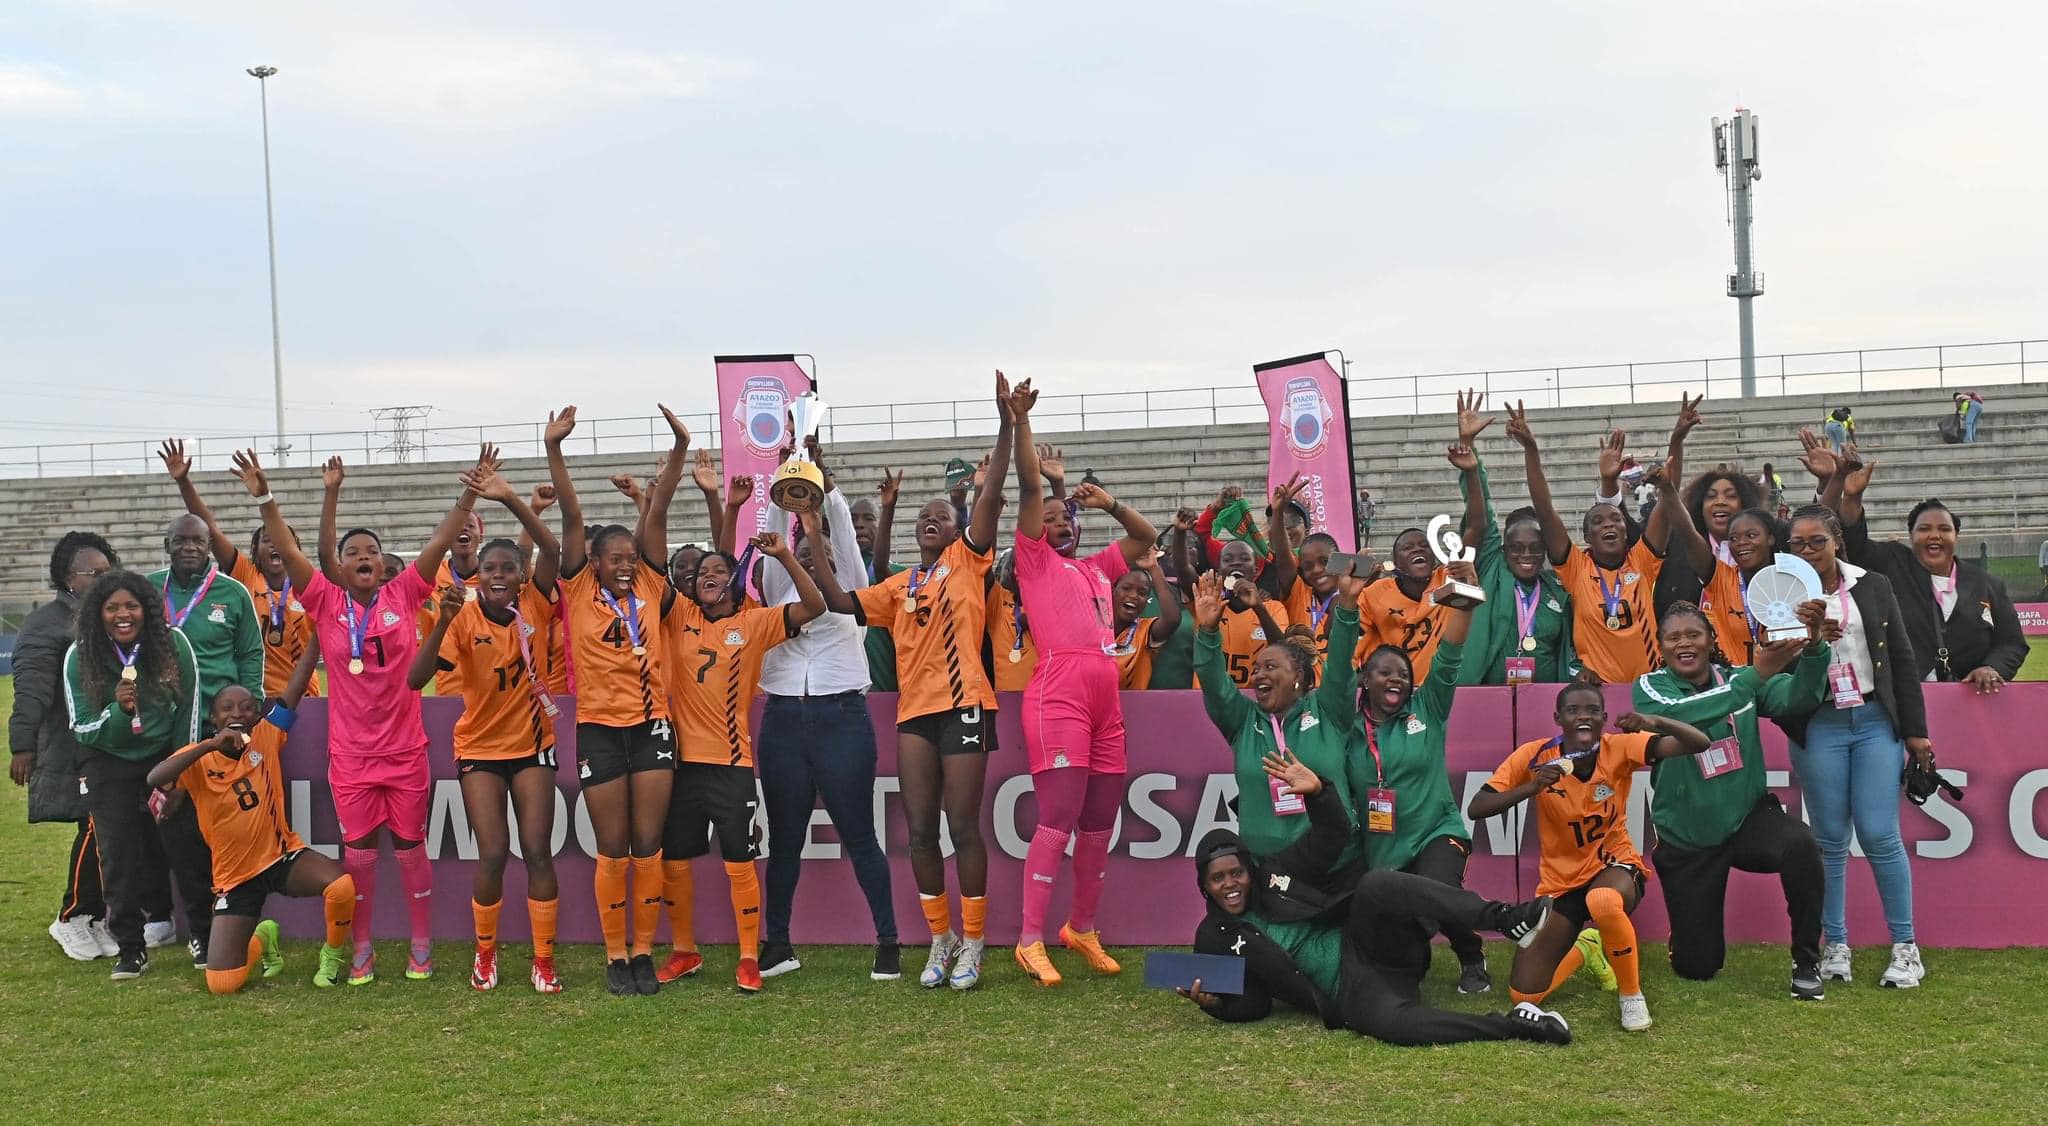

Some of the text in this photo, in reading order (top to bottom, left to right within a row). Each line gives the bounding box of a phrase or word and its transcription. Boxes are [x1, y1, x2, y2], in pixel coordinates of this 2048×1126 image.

[602, 618, 625, 649] 4
[364, 636, 385, 668] 1
[697, 648, 717, 684] 7
[650, 718, 671, 741] 4
[232, 777, 259, 812] 8
[1568, 815, 1606, 848] 12
